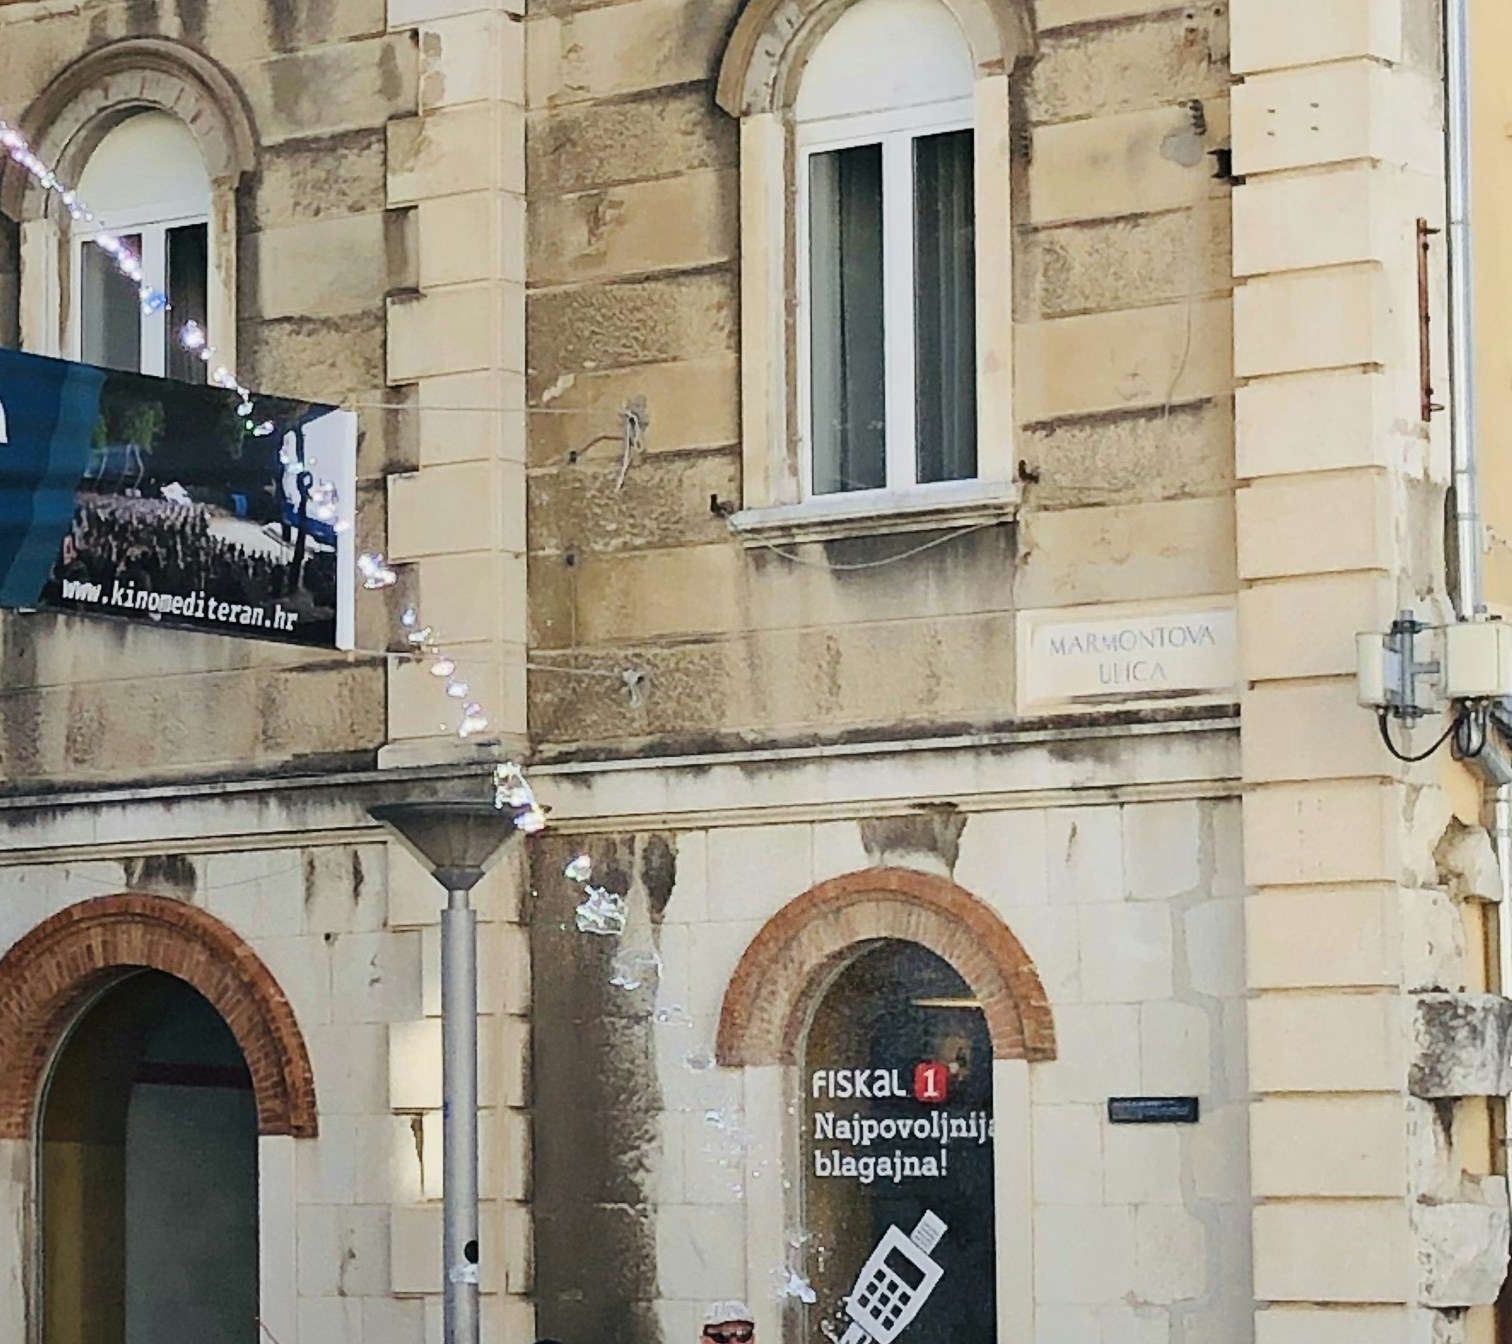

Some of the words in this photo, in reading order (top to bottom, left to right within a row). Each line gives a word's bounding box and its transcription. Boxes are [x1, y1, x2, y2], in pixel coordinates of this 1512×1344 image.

[61, 579, 299, 631] www.kinomediteran.hr
[1049, 624, 1216, 657] MARMONTOVA
[1098, 660, 1167, 685] ULICA
[922, 1068, 940, 1098] 1
[814, 1148, 948, 1184] blagajna!
